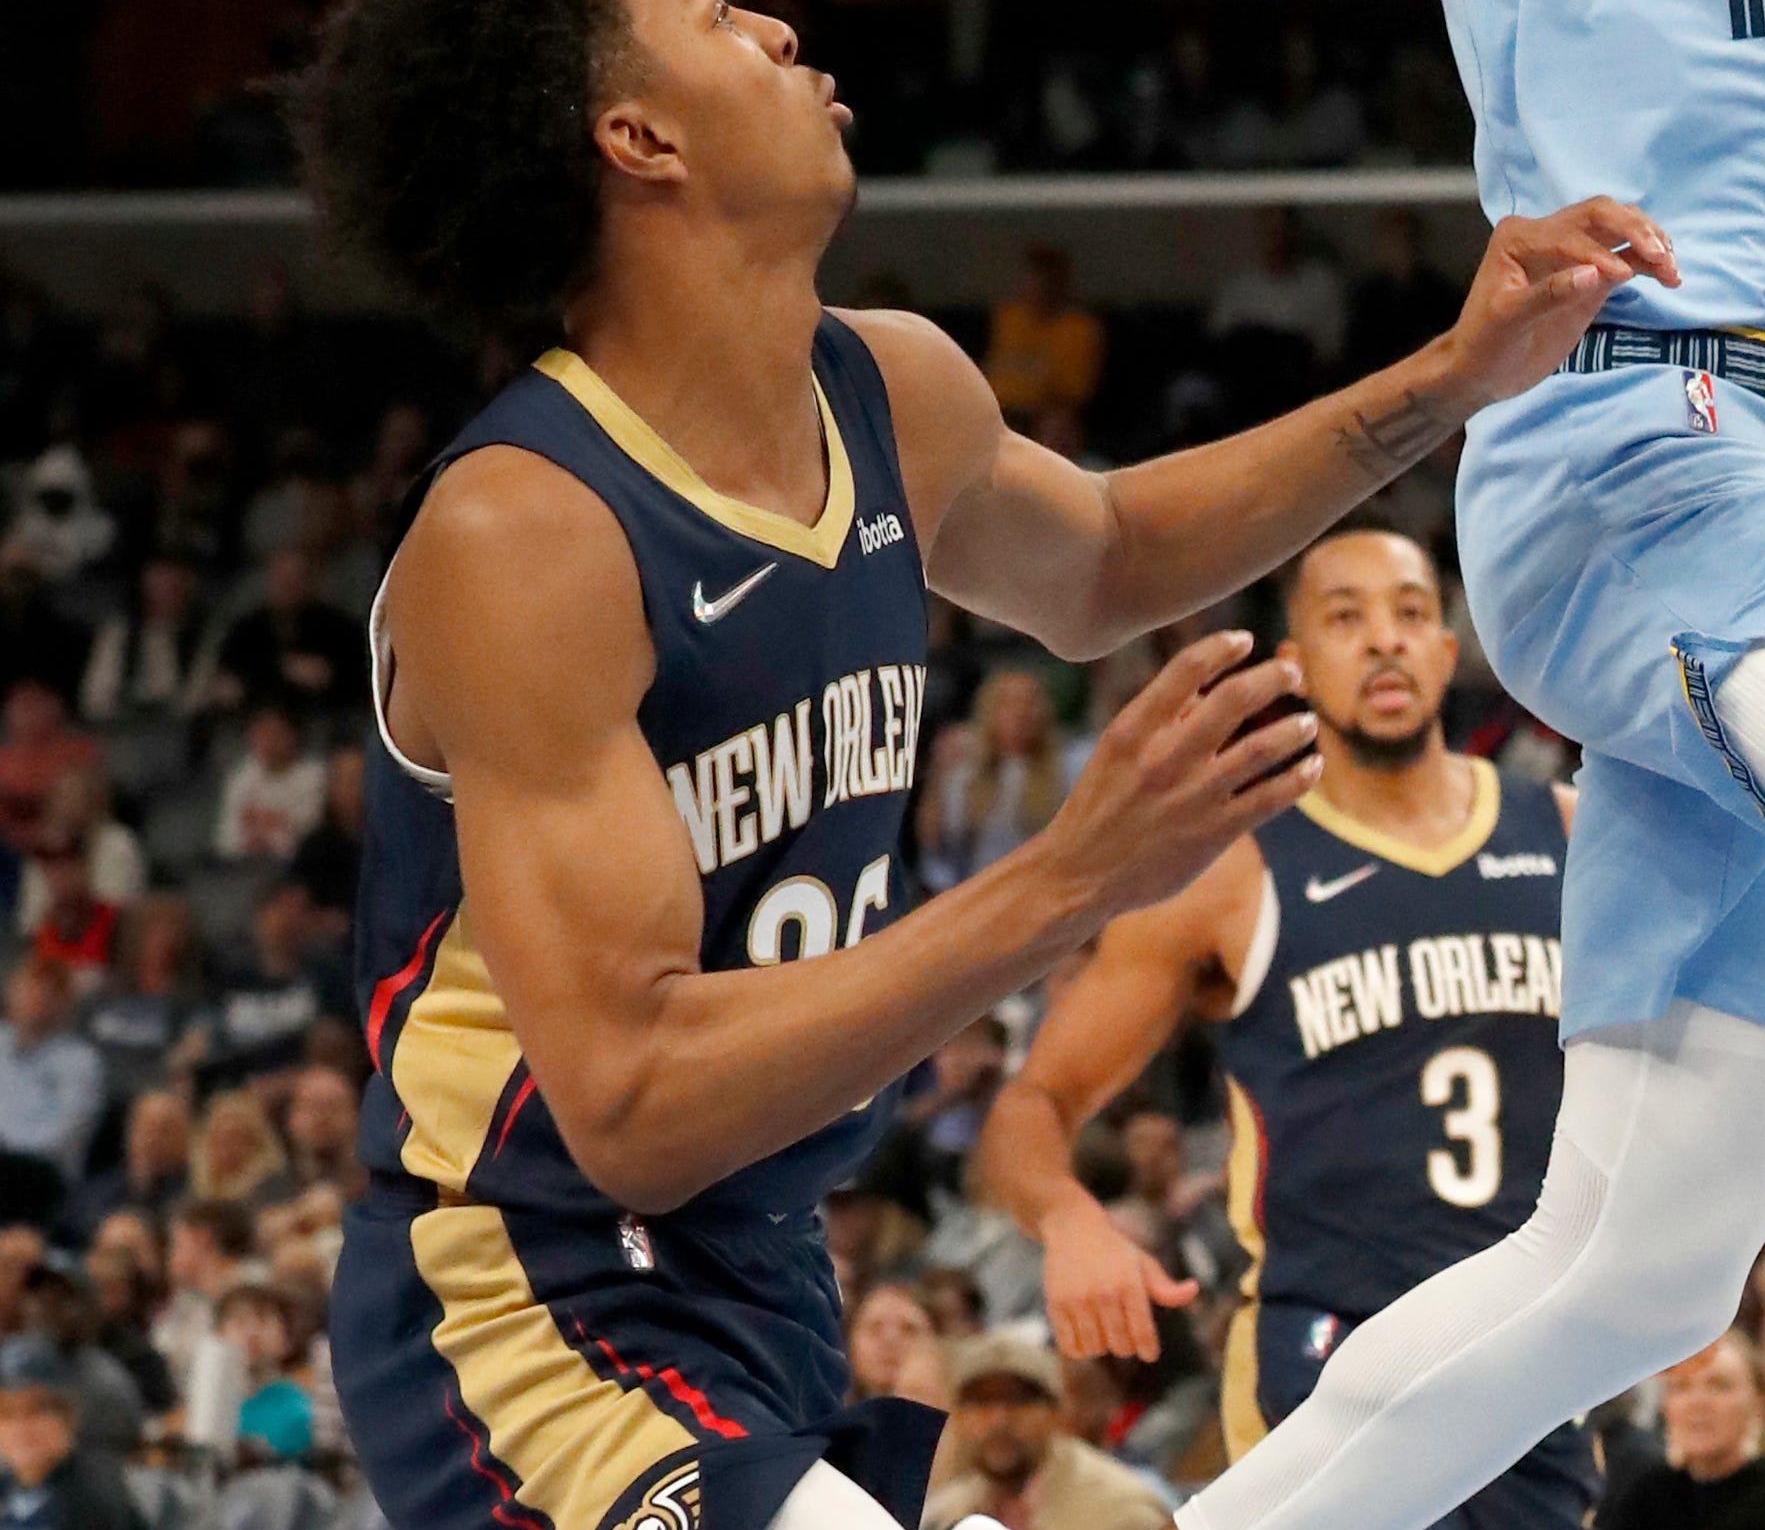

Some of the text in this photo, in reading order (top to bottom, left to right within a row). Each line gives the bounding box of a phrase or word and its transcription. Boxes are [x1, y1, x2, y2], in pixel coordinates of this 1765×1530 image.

[856, 512, 905, 556] ibotta
[666, 697, 813, 875] NEW
[1288, 943, 1403, 1061] NEW
[1419, 1043, 1503, 1209] 3
